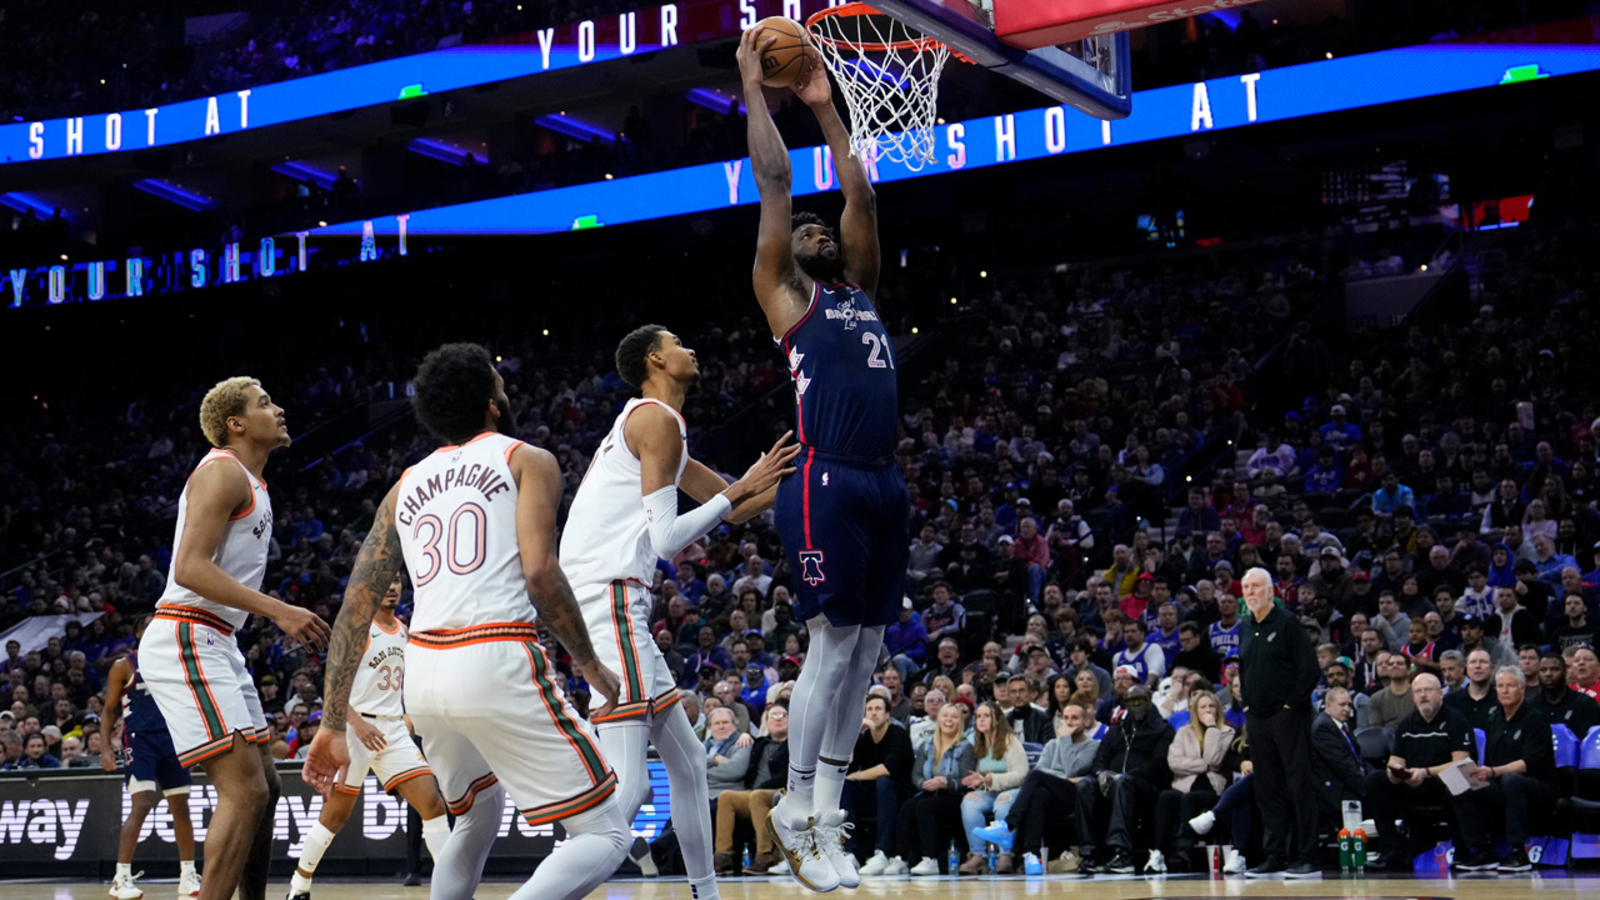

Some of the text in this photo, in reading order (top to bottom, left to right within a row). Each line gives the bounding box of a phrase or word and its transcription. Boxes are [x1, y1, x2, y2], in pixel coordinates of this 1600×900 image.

[537, 4, 678, 70] YOUR
[29, 89, 251, 159] SHOT AT
[724, 138, 879, 205] YUR
[1191, 73, 1260, 131] AT
[10, 214, 410, 307] YOUR SHOT AT
[862, 331, 895, 370] 21
[399, 463, 510, 526] CHAMPAGNIE
[413, 501, 487, 588] 30
[377, 665, 402, 691] 33
[121, 782, 323, 858] bety
